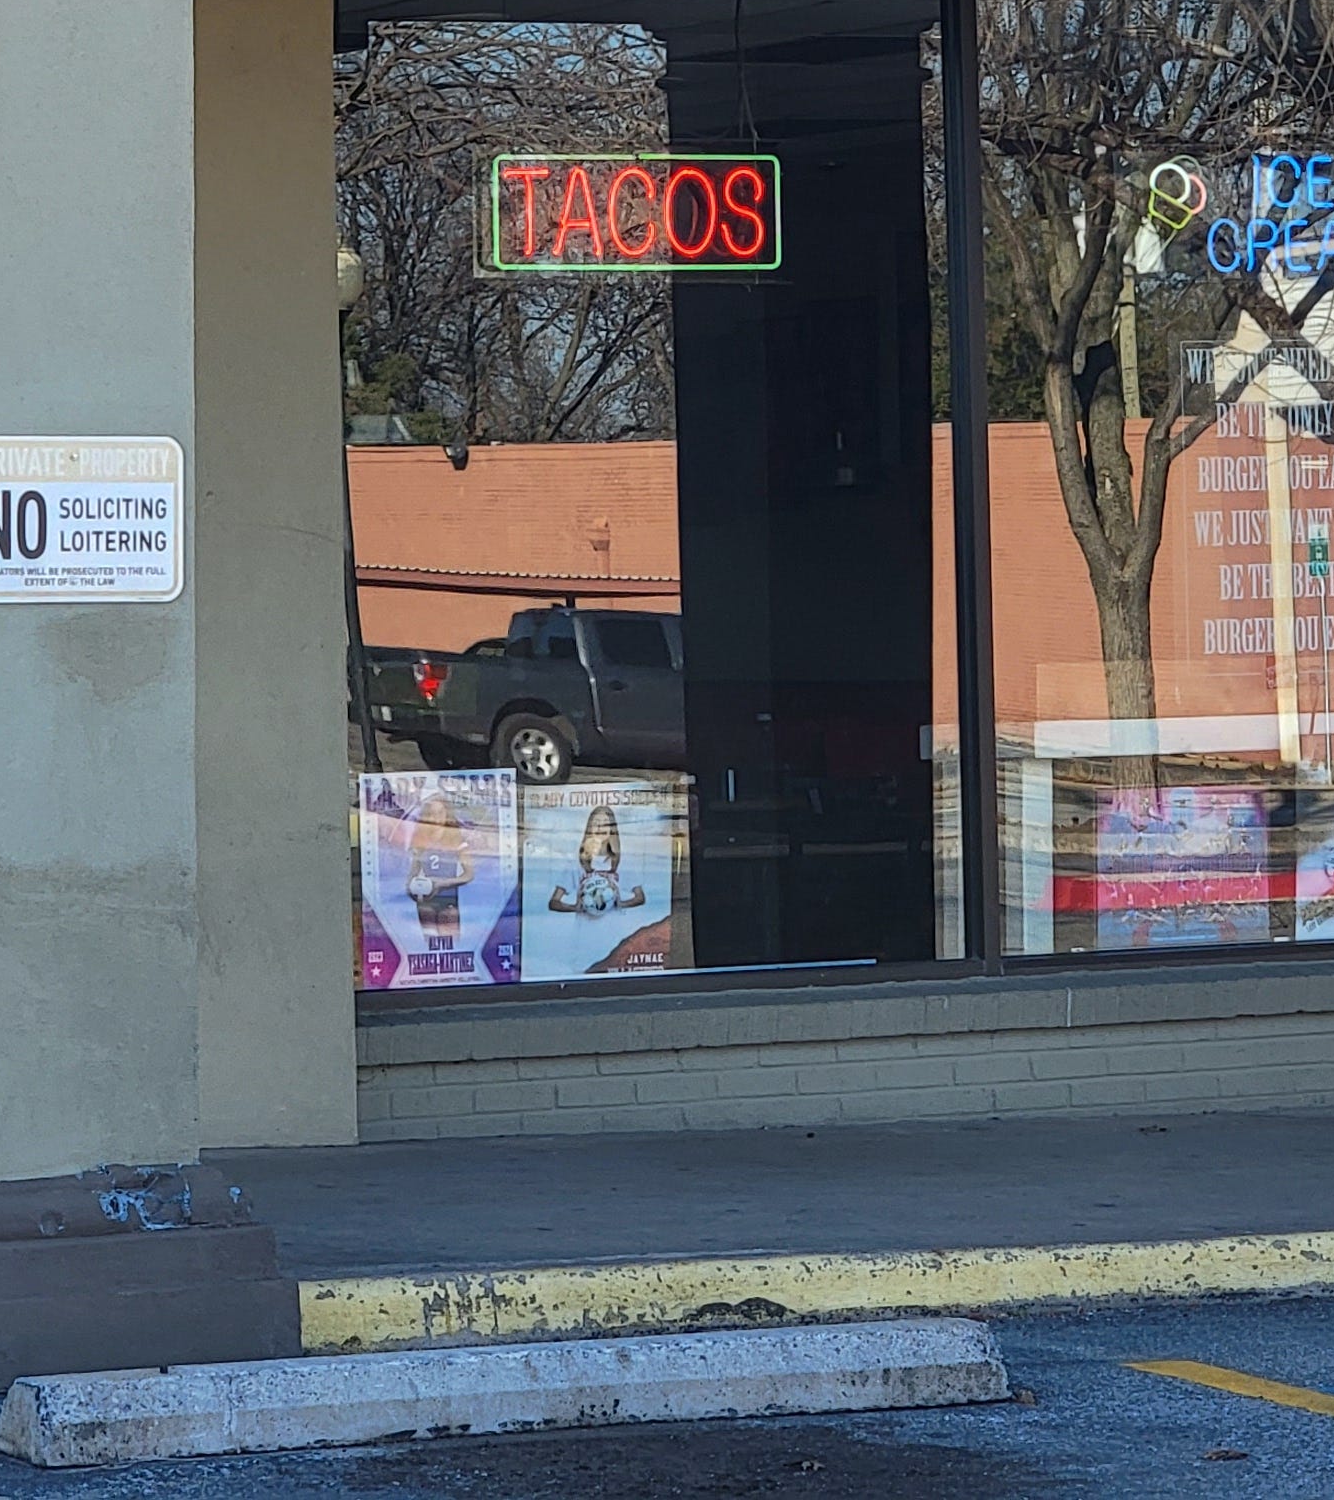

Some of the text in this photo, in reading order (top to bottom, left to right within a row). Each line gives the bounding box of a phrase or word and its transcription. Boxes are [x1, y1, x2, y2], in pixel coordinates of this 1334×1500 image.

[1251, 153, 1334, 209] ICE
[502, 165, 765, 258] TACOS
[1216, 402, 1240, 438] BE
[1287, 400, 1334, 437] ONLY
[79, 447, 170, 477] PROPERTY
[59, 497, 167, 520] SOLICITING
[59, 530, 167, 552] LOITERING
[1194, 510, 1224, 547] WE
[24, 577, 116, 587] EXTENT OF THE LAW
[27, 568, 47, 576] WILL
[48, 568, 59, 576] BE
[61, 567, 114, 576] PROSECUTED
[116, 567, 126, 576] TO
[128, 567, 143, 576] THE
[145, 567, 167, 575] FULL
[1220, 564, 1244, 601] BE
